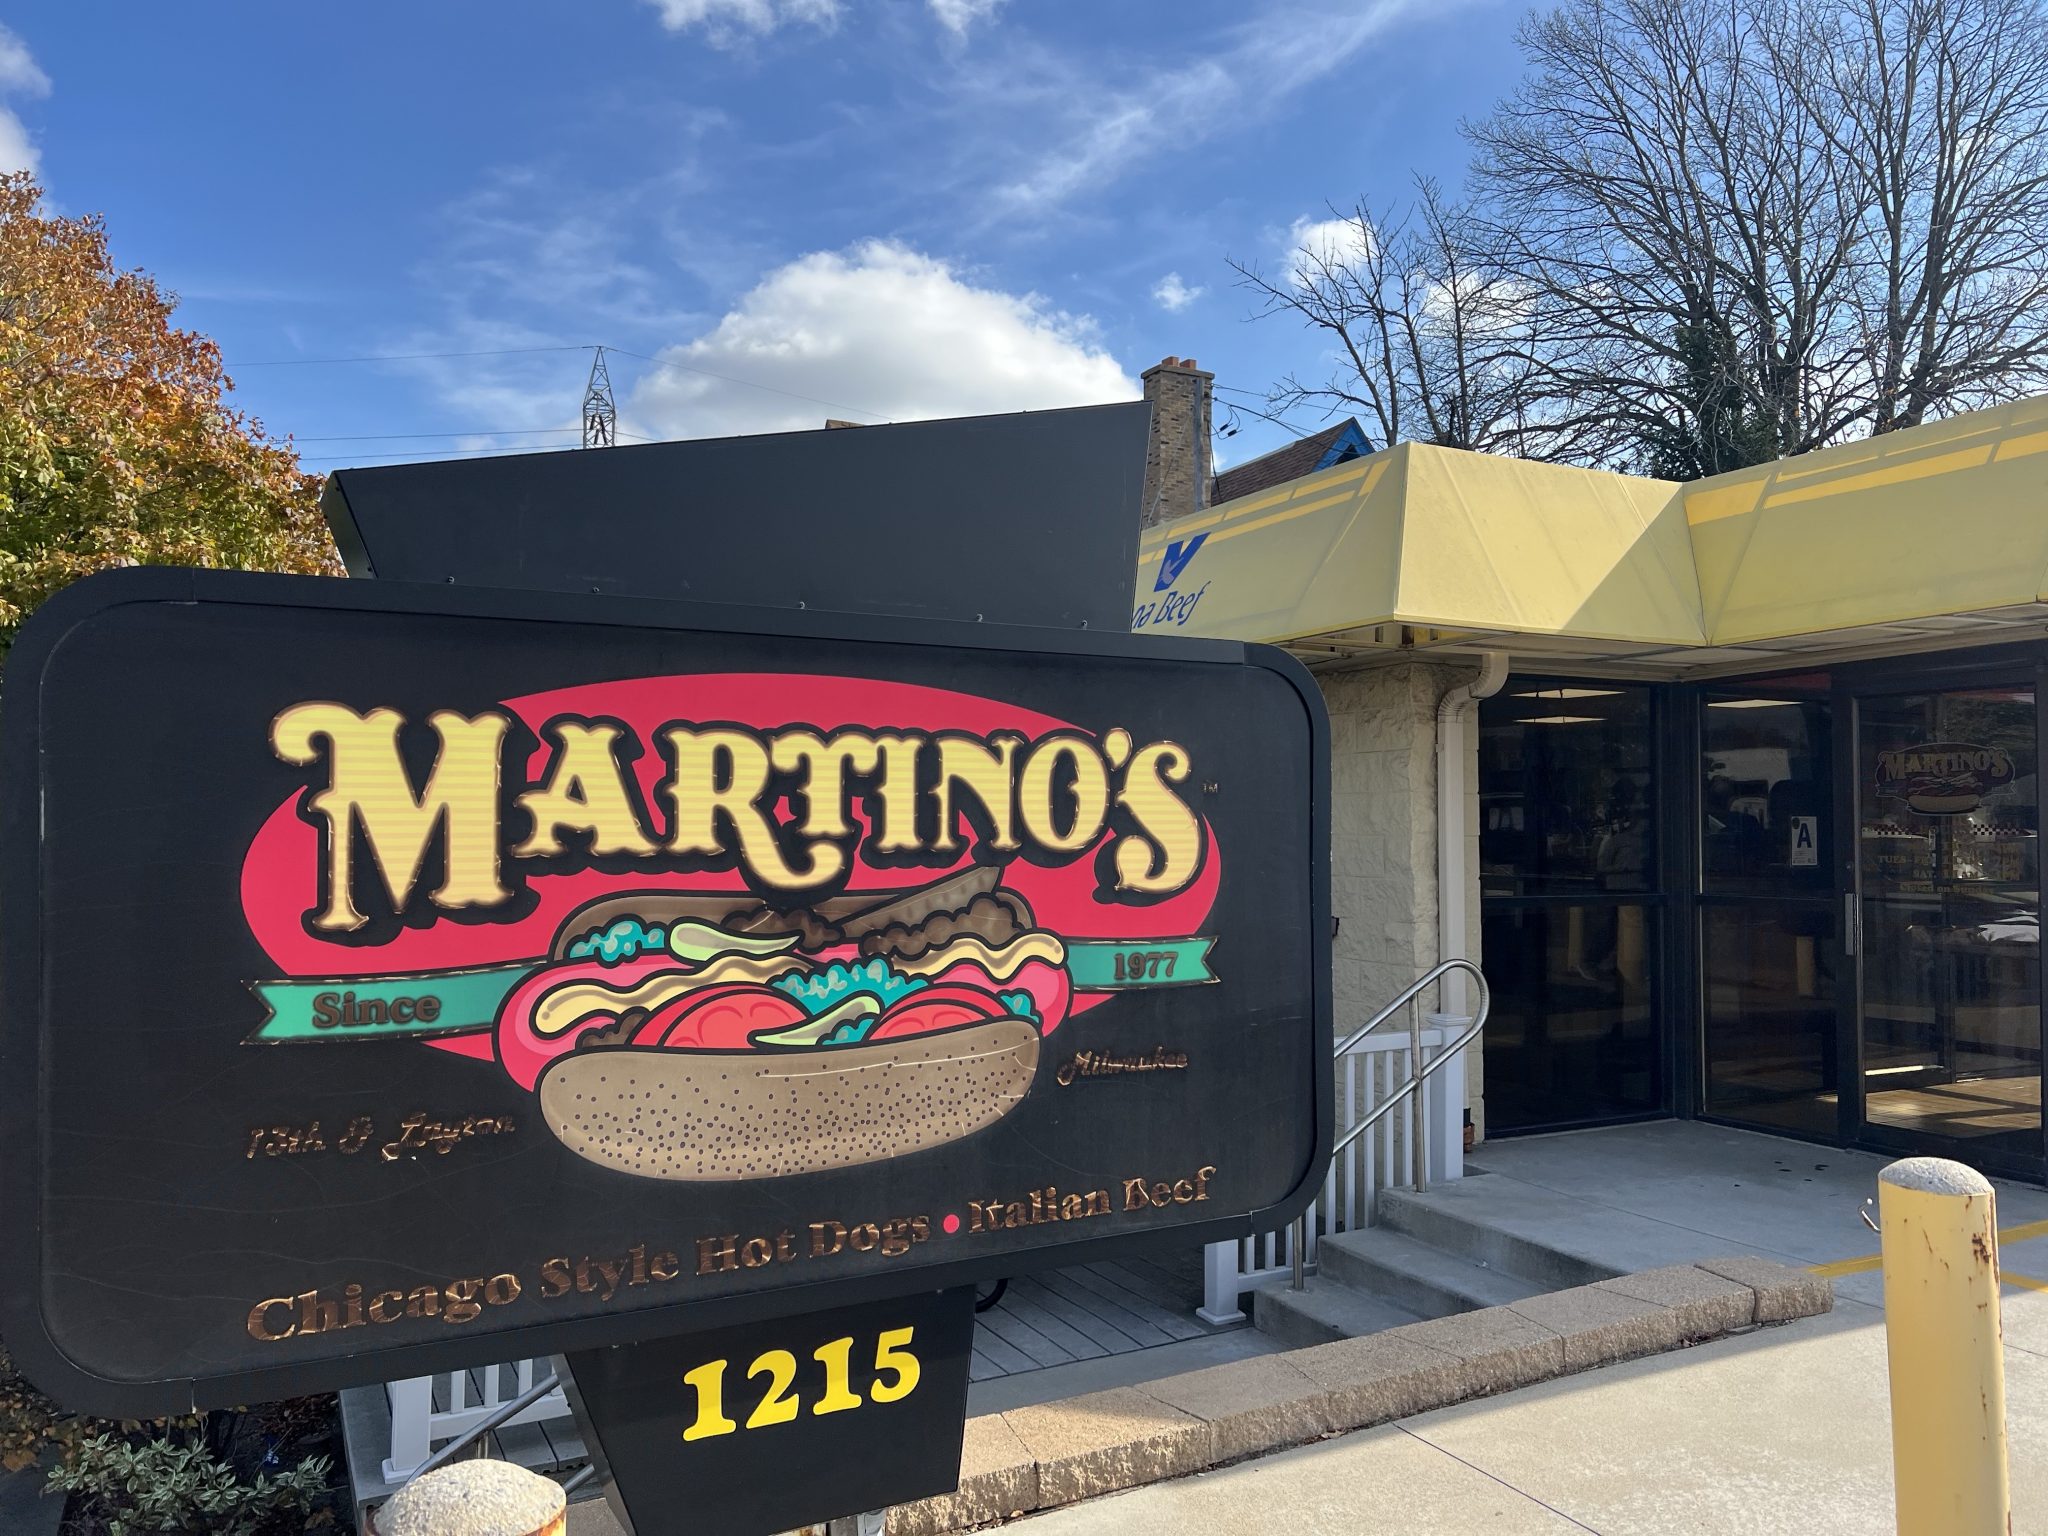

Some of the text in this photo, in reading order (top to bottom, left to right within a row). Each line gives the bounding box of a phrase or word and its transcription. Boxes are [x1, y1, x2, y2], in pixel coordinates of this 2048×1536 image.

[1153, 580, 1212, 626] Beef
[1879, 749, 2009, 783] MARTINO'S
[268, 700, 1202, 932] MARTINO'S
[1796, 823, 1812, 848] A
[1113, 952, 1179, 981] 1977
[311, 991, 441, 1029] Since
[246, 1165, 1217, 1341] Chicago Style Hot Dogs Italian Beef
[682, 1326, 922, 1442] 1215
